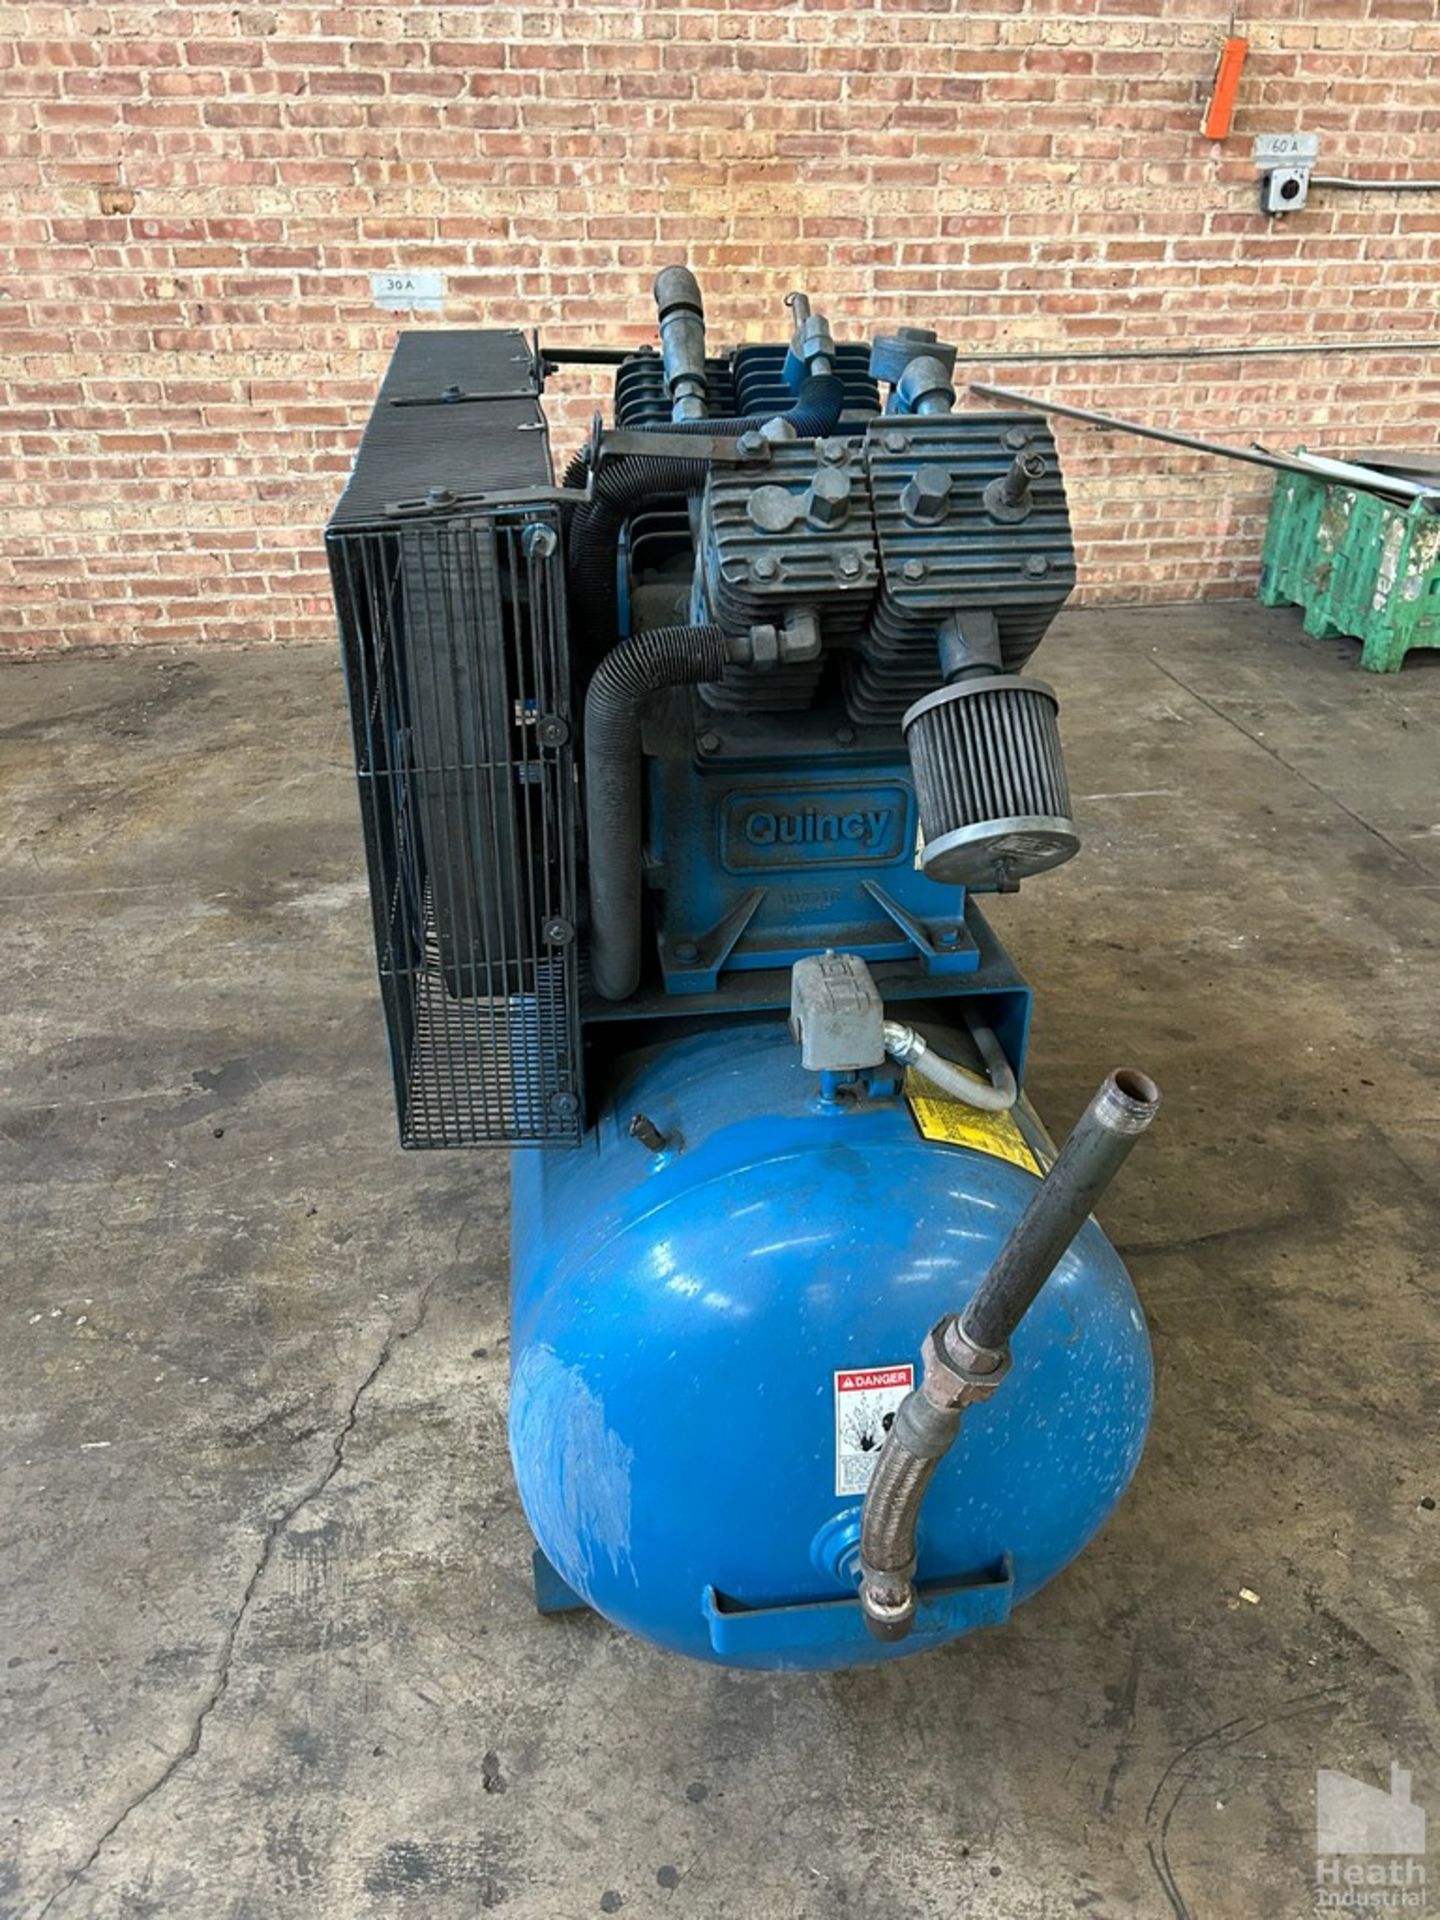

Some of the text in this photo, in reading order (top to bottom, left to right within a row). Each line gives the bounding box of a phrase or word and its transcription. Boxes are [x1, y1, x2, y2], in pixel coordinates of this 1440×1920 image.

[1272, 139, 1288, 153] 60
[746, 808, 892, 846] Quincy
[855, 1372, 907, 1388] DANGER
